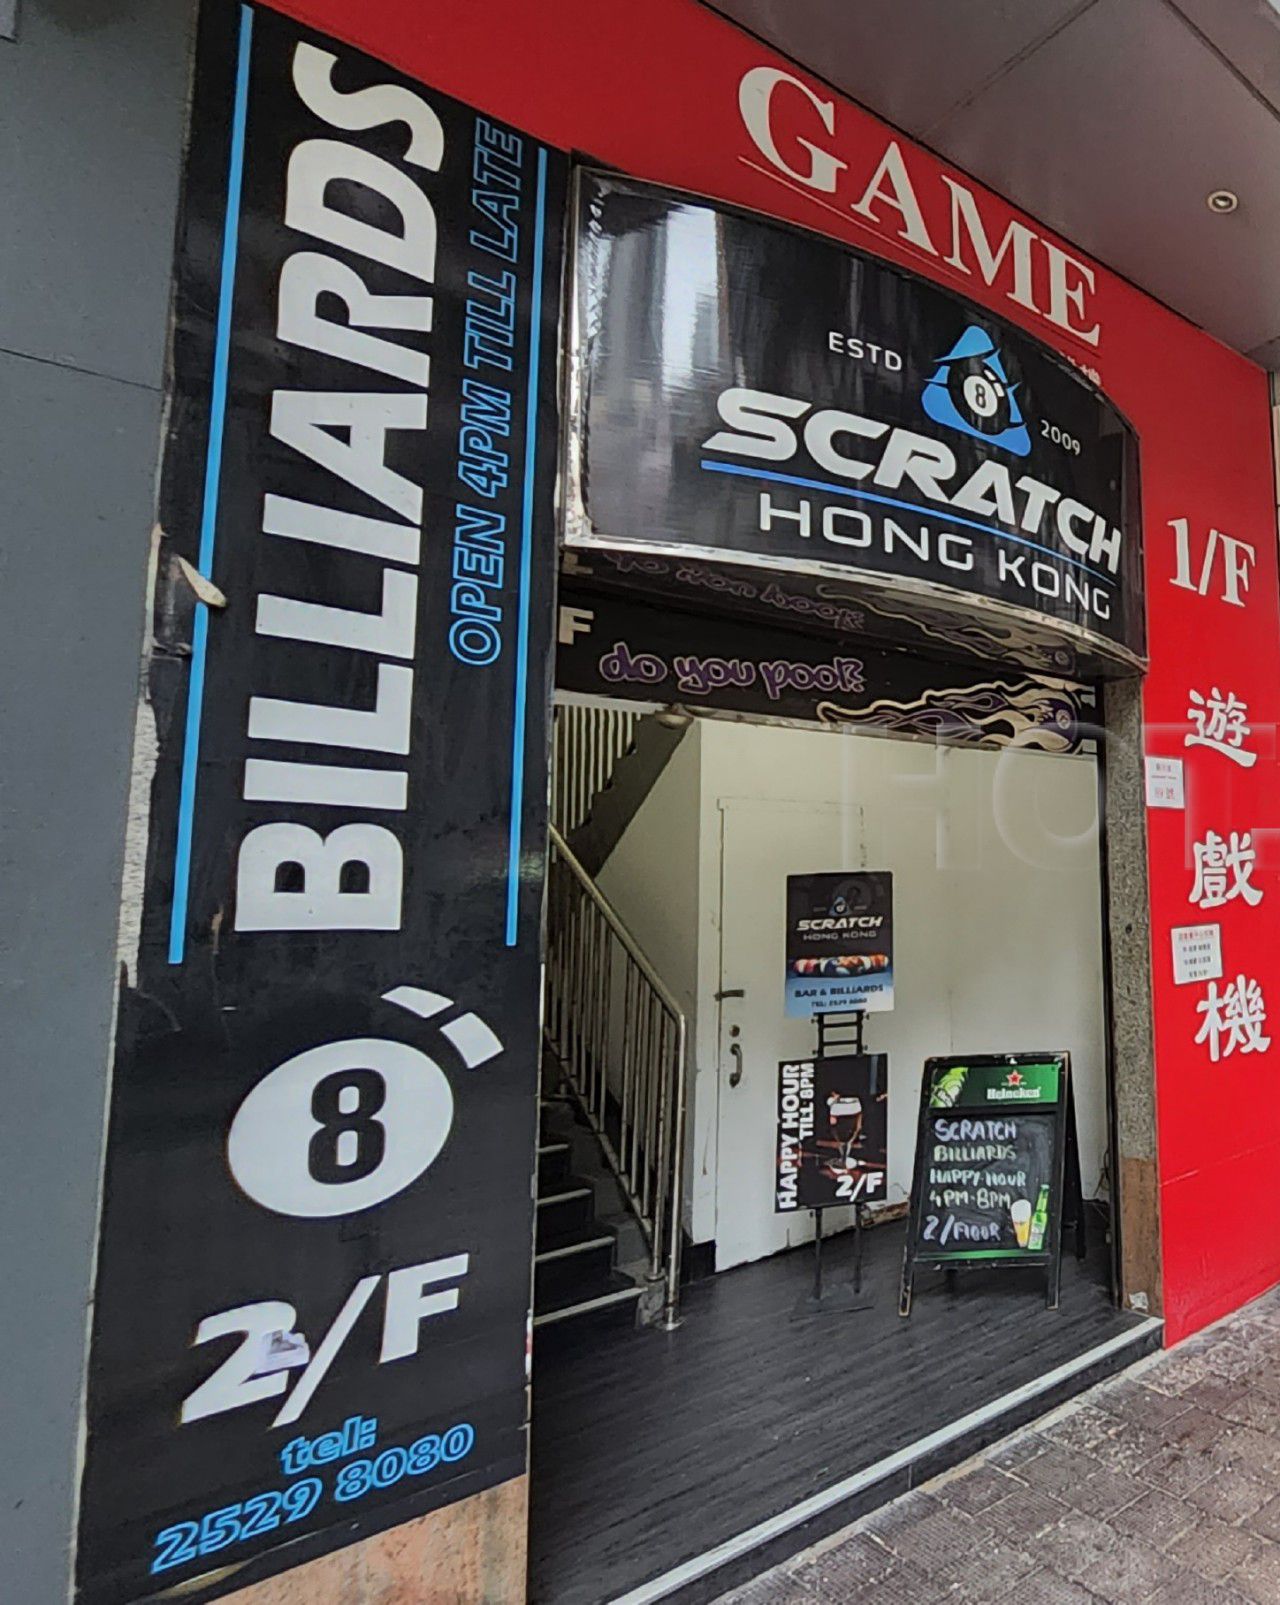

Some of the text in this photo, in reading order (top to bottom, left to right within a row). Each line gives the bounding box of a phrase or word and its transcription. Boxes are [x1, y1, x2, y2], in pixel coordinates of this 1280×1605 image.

[738, 66, 1100, 347] GAME
[449, 116, 523, 666] OPEN 4PM TILL LATE
[827, 331, 903, 372] ESTD
[234, 41, 445, 932] BILLIARDS
[701, 387, 1122, 574] SCRATCH
[1040, 419, 1082, 457] 2009
[759, 491, 1111, 620] HONG KONG
[1166, 517, 1256, 607] 1/F
[600, 642, 667, 684] do
[673, 656, 756, 694] you
[797, 916, 883, 931] SCRATCH
[1183, 688, 1272, 1063] 遊戲機
[308, 1068, 386, 1185] 8
[778, 1063, 800, 1210] HAPPY HOUR
[799, 1062, 815, 1141] TILL 8PM
[935, 1119, 1016, 1141] SCRATCH
[835, 1171, 884, 1203] 2/F
[933, 1145, 1017, 1162] BILLIARDS
[180, 1253, 470, 1429] 2/F
[280, 1414, 378, 1476] tel:
[150, 1422, 475, 1575] 2529 8080
